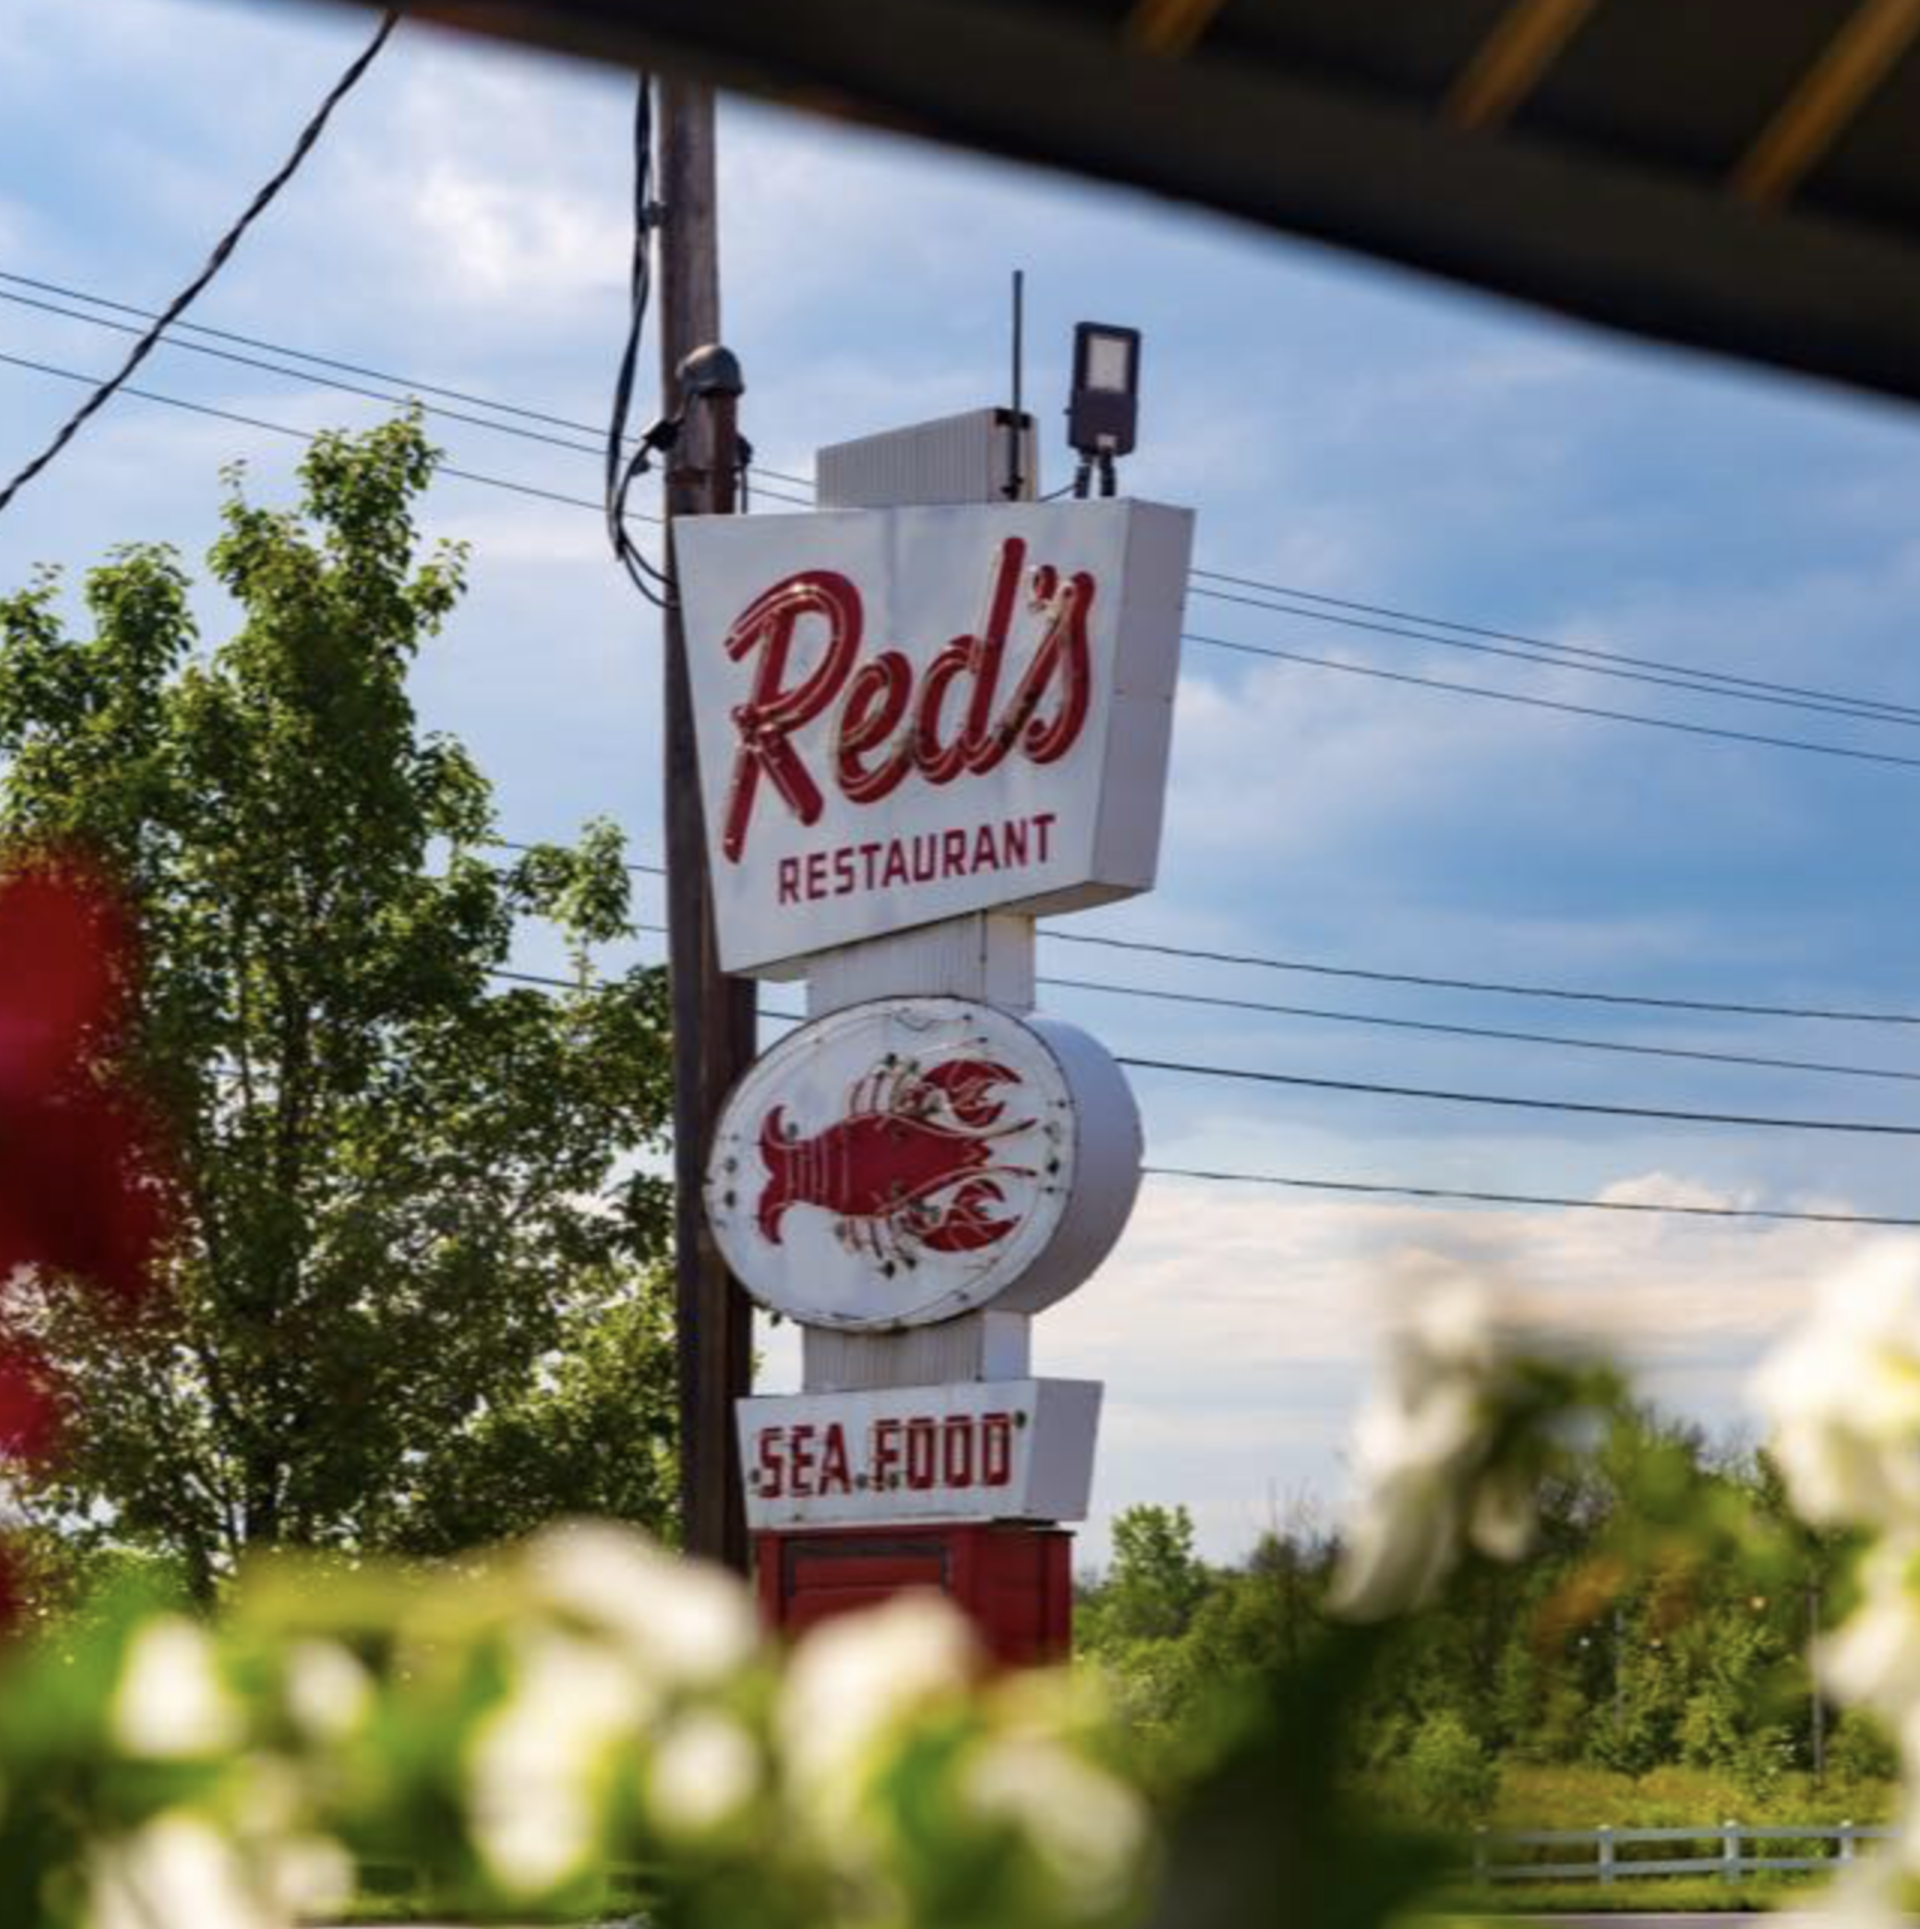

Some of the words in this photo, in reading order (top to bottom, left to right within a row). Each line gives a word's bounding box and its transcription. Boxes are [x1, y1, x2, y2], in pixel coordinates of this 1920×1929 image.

[724, 536, 1095, 865] Red's
[778, 813, 1057, 905] RESTAURANT
[758, 1422, 852, 1498] SEA
[873, 1412, 1012, 1492] FOOD
